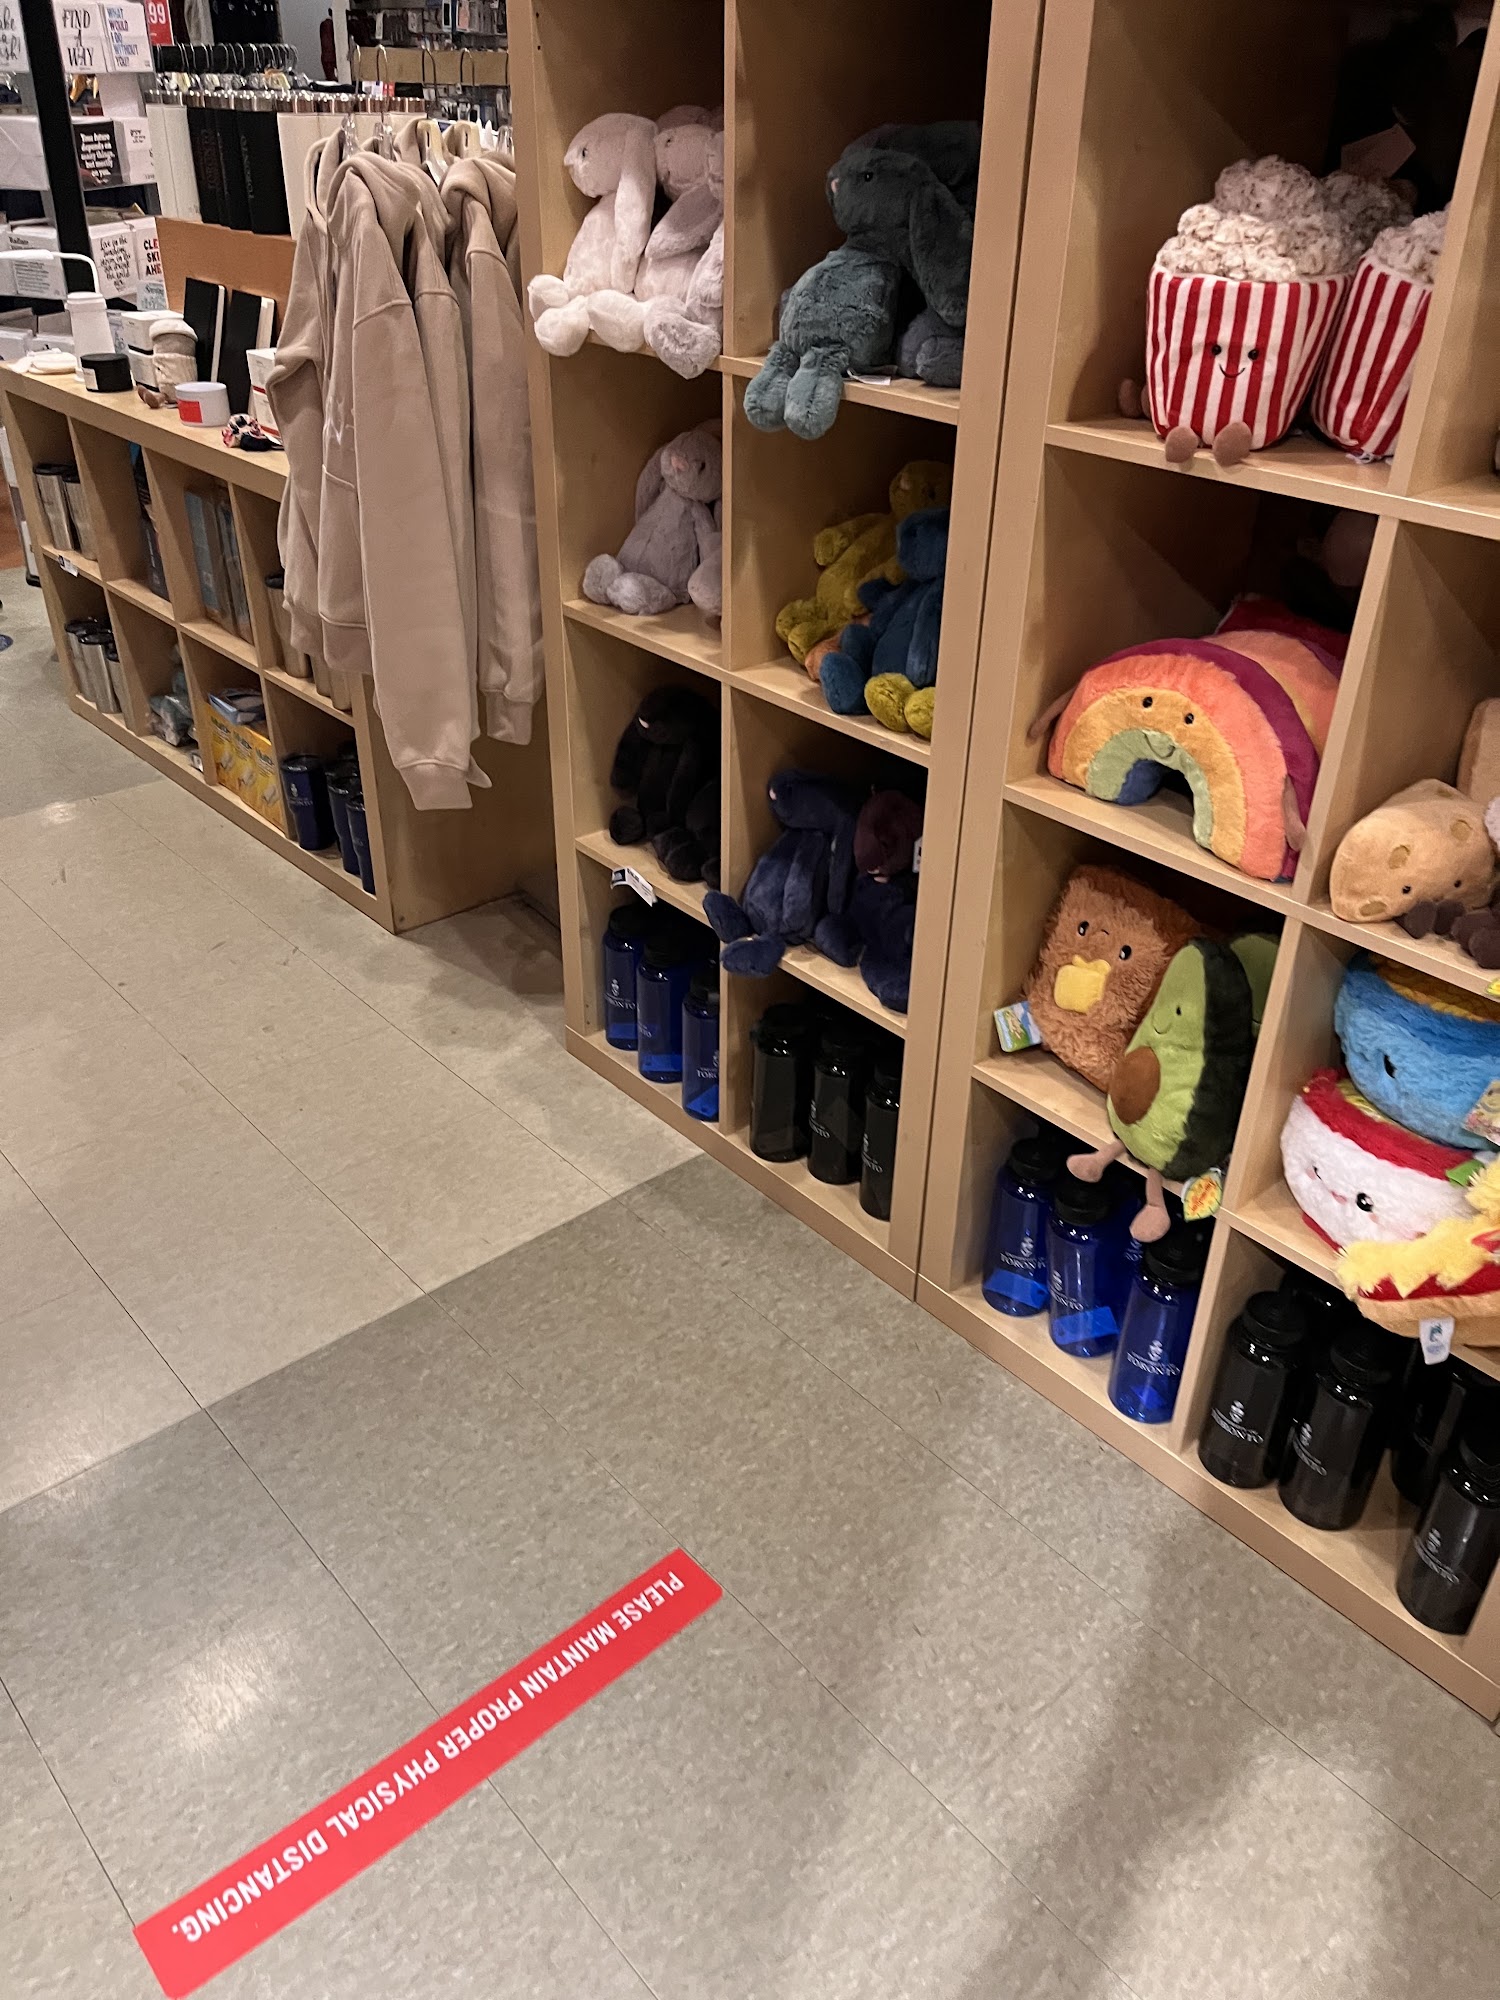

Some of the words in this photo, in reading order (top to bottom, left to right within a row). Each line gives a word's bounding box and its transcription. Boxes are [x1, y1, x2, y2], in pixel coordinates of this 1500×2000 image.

[62, 8, 91, 29] FIND
[67, 47, 94, 67] WAY
[611, 1571, 684, 1631] PLEASE
[521, 1620, 618, 1700] MAINTAIN
[437, 1687, 523, 1760] PROPER
[326, 1747, 441, 1839] PHYSICAL
[171, 1828, 328, 1943] DISTANCING.
